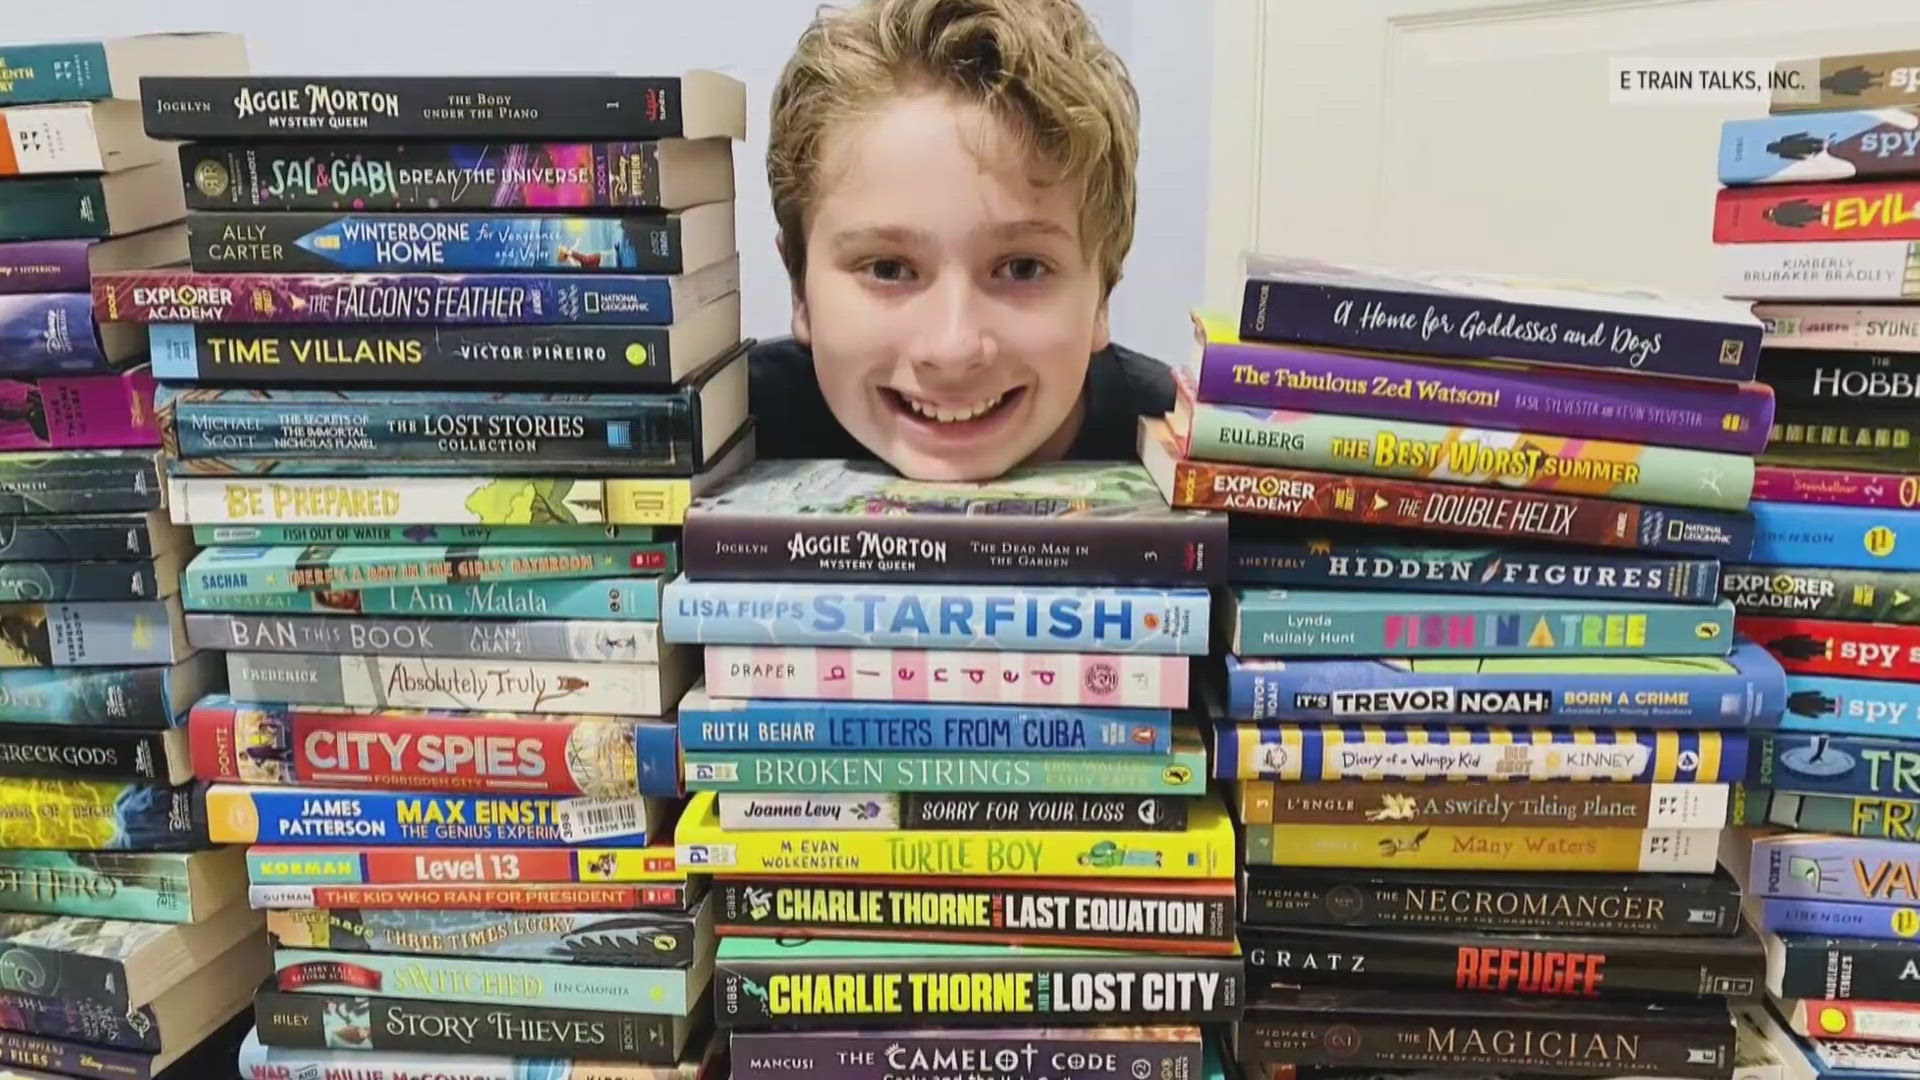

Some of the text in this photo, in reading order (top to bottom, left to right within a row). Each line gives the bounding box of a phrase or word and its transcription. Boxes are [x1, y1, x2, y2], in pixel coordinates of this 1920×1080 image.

[234, 85, 399, 118] AGGIE MORTON
[269, 116, 368, 128] MYSTERY QUEEN
[423, 107, 538, 119] UNDER THE PIANO
[502, 168, 589, 184] UNIVERSE
[222, 225, 266, 241] ALLY
[343, 222, 470, 242] WINTERBORNE
[208, 244, 283, 261] CARTER
[376, 241, 444, 264] HOME
[1783, 256, 1854, 269] KIMBERLY
[1744, 269, 1894, 281] BRUBAKER BRADLEY
[133, 285, 233, 307] EXPLORER
[335, 286, 524, 318] FALCON'S FEATHER
[148, 306, 224, 320] ACADEMY
[1256, 285, 1270, 331] CONNOR
[1333, 300, 1662, 367] A Home for Goddesses and Dogs
[207, 338, 280, 364] TIME
[290, 338, 422, 364] VILLAINS
[460, 343, 607, 361] VICTOR PIÑEIRO
[1232, 364, 1500, 408] The Fabulous Zed Watson!
[387, 415, 584, 437] THE LOST STORIES
[202, 431, 257, 448] SCOTT
[438, 439, 536, 451] COLLECTION
[1219, 427, 1640, 485] EULBERG THE BEST WORST SUMMER
[1213, 475, 1315, 500] EXPLORER
[224, 482, 400, 519] BE PREPARED
[1223, 494, 1303, 513] ACADEMY
[1397, 492, 1578, 535] THE DOUBLE HELIX
[282, 527, 391, 541] FISH OUT OF WATER
[716, 531, 1089, 563] JOCELYN AGGIE MORTON THE DEAD MAN IN
[820, 559, 915, 571] MYSTERY QUEEN
[991, 556, 1069, 567] THE GARDEN
[202, 573, 248, 590] SACHAR
[1239, 557, 1306, 569] SHETTERLY
[1328, 556, 1473, 581] HIDDEN
[1503, 563, 1663, 589] FIGURES
[1723, 574, 1835, 597] EXPLORER
[463, 582, 548, 615] Malala
[1736, 595, 1821, 610] ACADEMY
[679, 594, 1133, 640] LISA FIPPS STARFISH
[1287, 614, 1332, 629] Lynda
[230, 620, 433, 649] BAN THIS BOOK
[472, 626, 516, 639] ALAN
[1263, 632, 1355, 646] Mullaly Hunt
[1383, 614, 1477, 649] FISH
[1560, 614, 1647, 648] TREE
[1840, 641, 1900, 668] spy
[241, 668, 318, 683] FREDERICK
[731, 664, 795, 678] DRAPER
[387, 662, 546, 703] Absolutely Truly
[1337, 691, 1449, 712] TREVOR
[1564, 692, 1612, 706] BORN
[1617, 692, 1631, 706] A
[1635, 692, 1689, 706] CRIME
[1849, 699, 1907, 725] spy
[702, 721, 749, 742] RUTH
[758, 722, 815, 742] BEHAR
[829, 717, 932, 748] LETTERS
[944, 718, 1011, 748] FROM
[1023, 719, 1086, 748] CUBA
[63, 748, 118, 767] GODS
[304, 729, 546, 777] CITY SPIES
[1342, 751, 1383, 769] Diary
[1411, 753, 1455, 769] Wimpy
[1458, 752, 1480, 768] Kid
[1567, 753, 1634, 768] KINNEY
[756, 758, 883, 786] BROKEN
[897, 758, 1030, 786] STRINGS
[301, 800, 362, 817] JAMES
[396, 800, 466, 824] MAX
[744, 800, 841, 820] Joanne Levy
[922, 802, 1124, 822] SORRY FOR YOUR LOSS
[1288, 799, 1355, 811] L'ENGLE
[1422, 795, 1637, 822] A Swiftly Tilting Planet
[279, 819, 491, 840] PATTERSON THE GENIUS
[801, 841, 840, 853] EVAN
[885, 837, 1043, 873] TURTLE BOY
[1452, 835, 1597, 855] Many Waters
[261, 862, 351, 875] KORMAN
[415, 854, 520, 880] Level 13
[763, 856, 860, 869] WOLKENSTEIN
[326, 891, 626, 904] THE KID WHO RAN FOR PRESIDENT
[1375, 888, 1664, 920] THE NECROMANCER
[776, 888, 884, 922] CHARLIE
[889, 891, 990, 926] THORNE
[1005, 895, 1070, 930] LAST
[1076, 898, 1204, 935] EQUATION
[1250, 949, 1365, 973] GRATZ
[1456, 946, 1606, 997] REFUGEE
[727, 977, 738, 1014] GIBBS
[769, 975, 902, 1014] CHARLIE
[909, 973, 1033, 1013] THORNE
[1053, 973, 1136, 1012] LOST
[1142, 972, 1219, 1011] CITY
[273, 1015, 310, 1027] RILEY
[387, 1006, 605, 1044] STORY THIEVES
[1397, 1027, 1639, 1060] THE MAGICIAN
[11, 1051, 48, 1066] FILES
[751, 1058, 813, 1070] MANCUSI
[837, 1043, 1117, 1073] THE CAMELOT CODE
